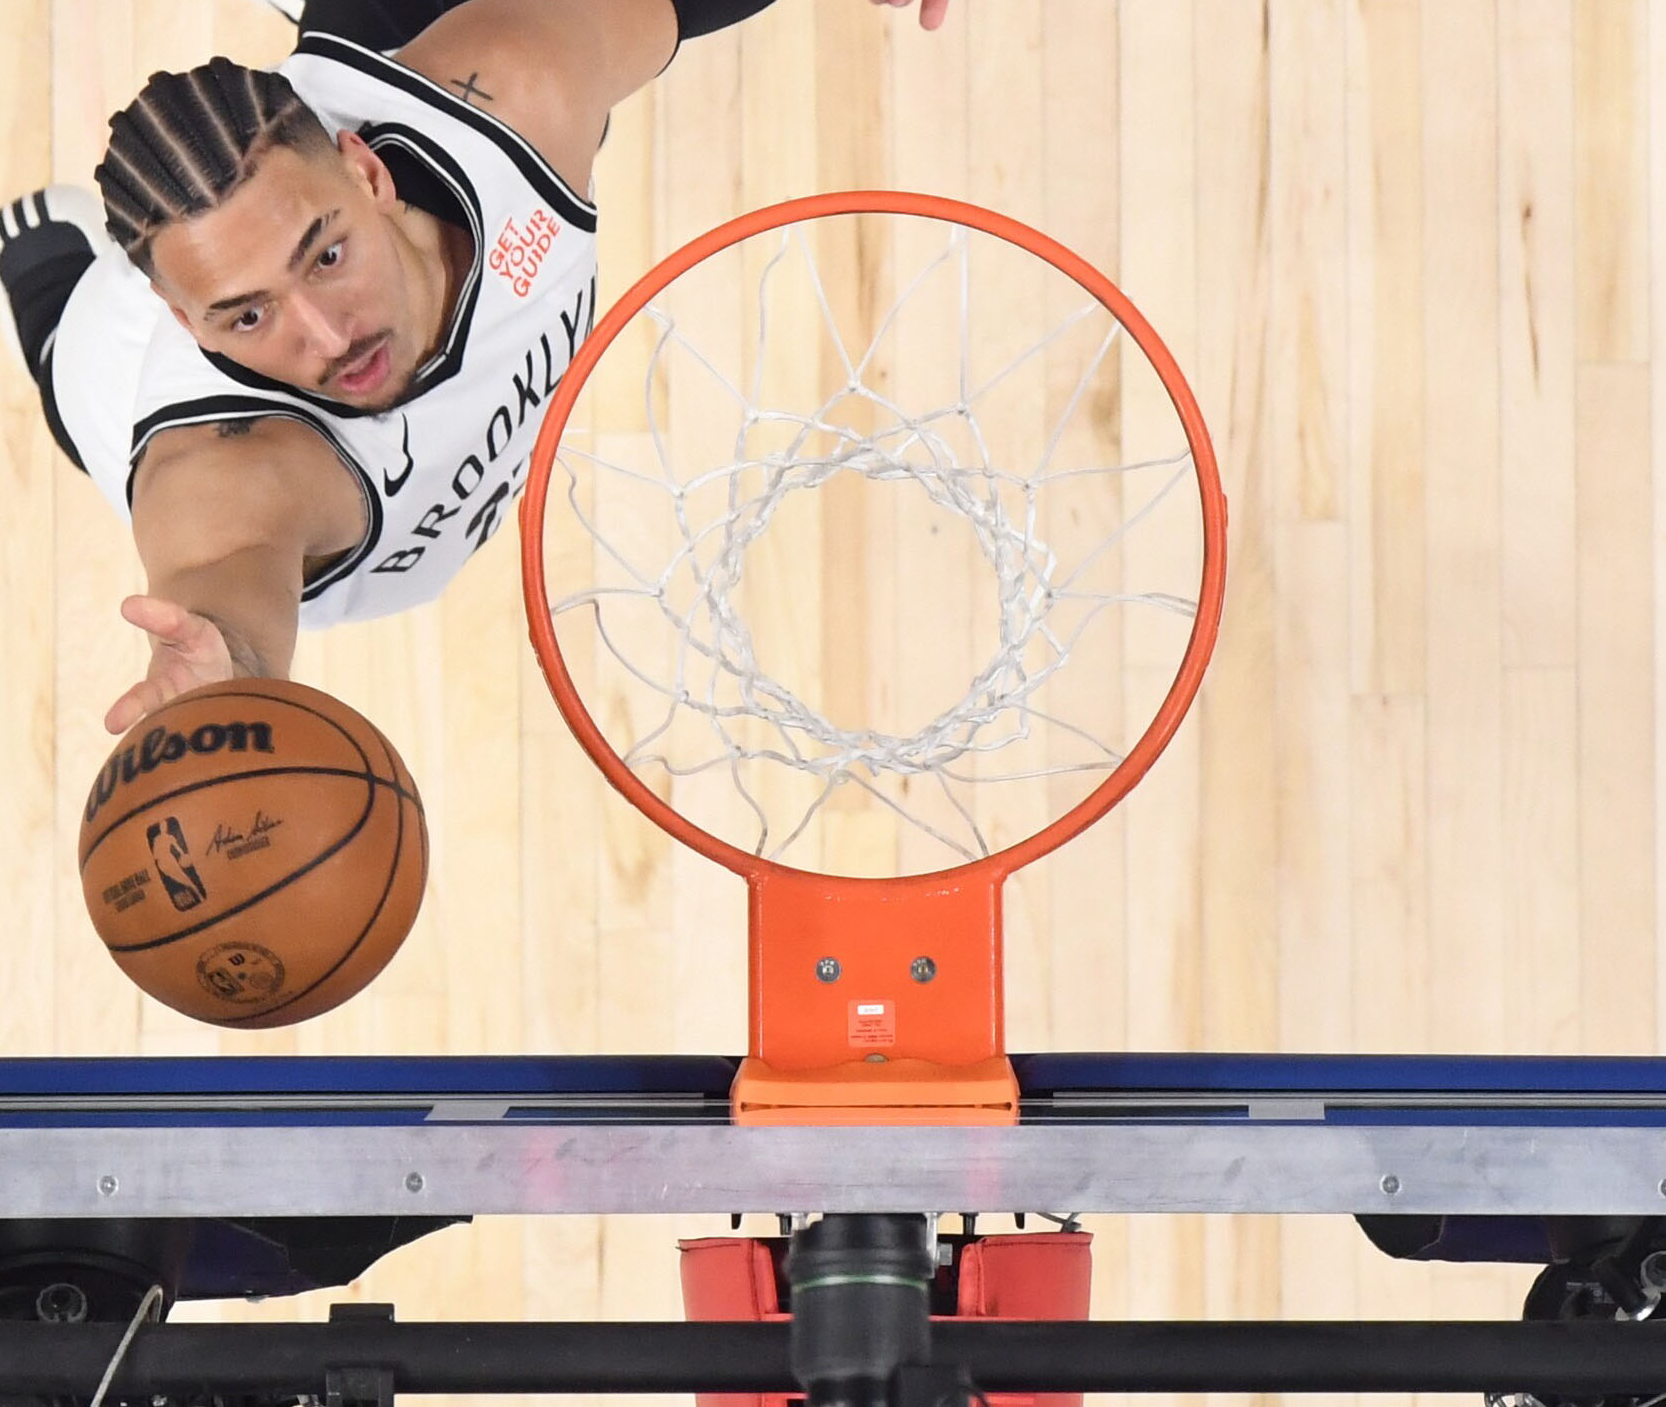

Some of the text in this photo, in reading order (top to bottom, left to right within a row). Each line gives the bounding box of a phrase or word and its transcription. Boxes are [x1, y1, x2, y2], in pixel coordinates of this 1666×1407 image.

[489, 216, 519, 271] GET
[499, 209, 548, 280] YOUR
[514, 216, 561, 297] GUIDE
